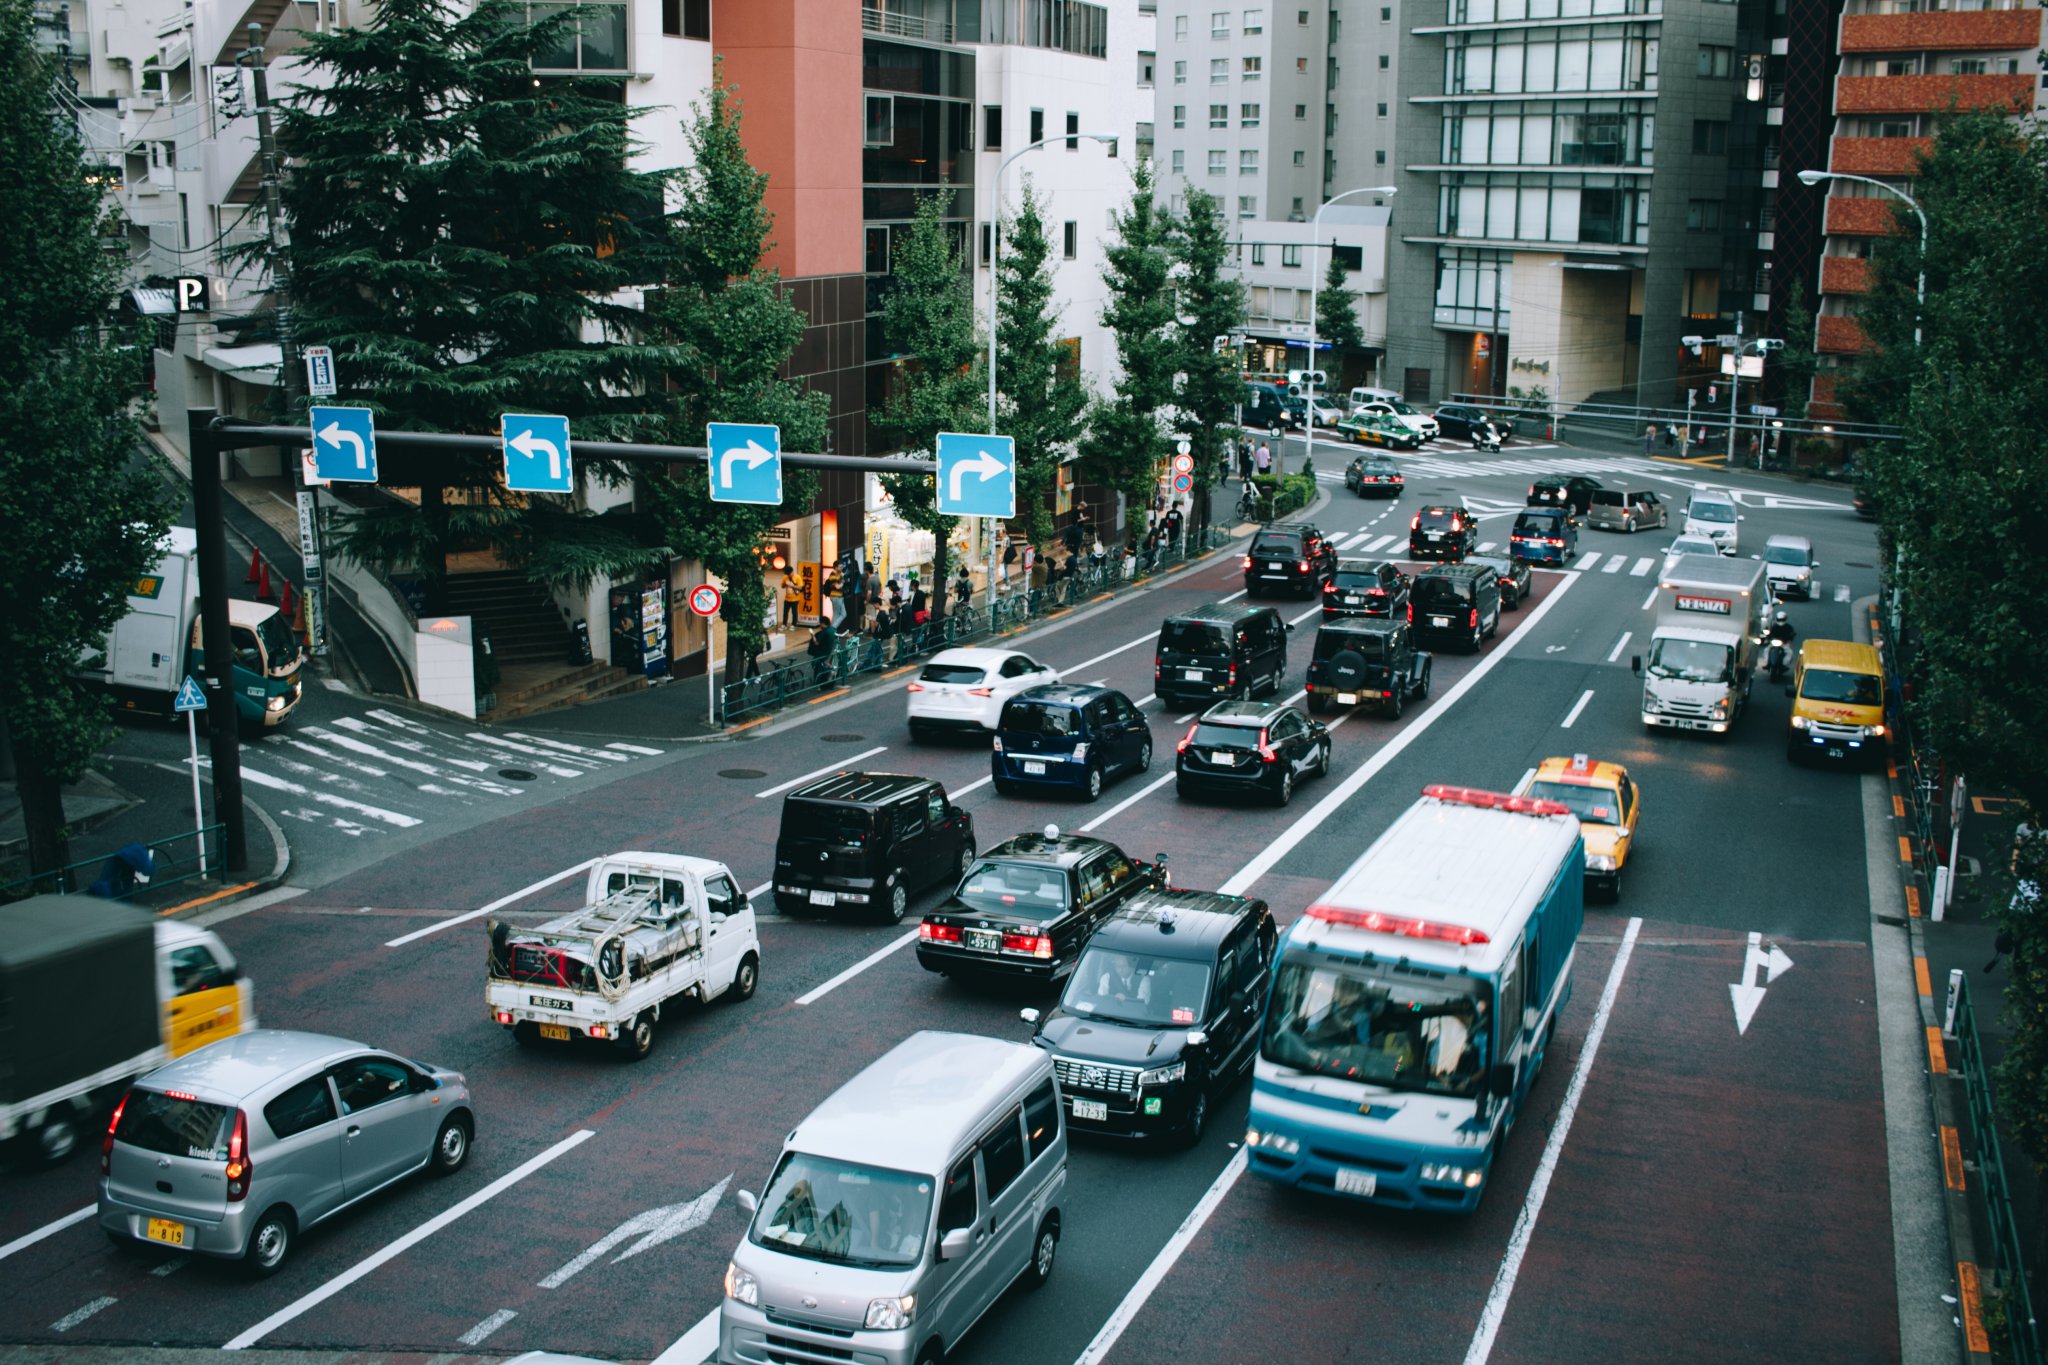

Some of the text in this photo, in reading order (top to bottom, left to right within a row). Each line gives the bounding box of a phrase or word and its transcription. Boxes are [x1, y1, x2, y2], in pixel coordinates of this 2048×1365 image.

[179, 279, 203, 311] P
[315, 357, 328, 385] KEN
[803, 566, 813, 612] 処方せん
[1338, 666, 1356, 676] Jeep
[1824, 707, 1857, 718] DHL
[533, 996, 570, 1010] 高圧ガス
[547, 1028, 568, 1038] 74-17
[1081, 1107, 1106, 1120] 17-33
[189, 1145, 217, 1160] kiseido
[161, 1228, 182, 1243] 819
